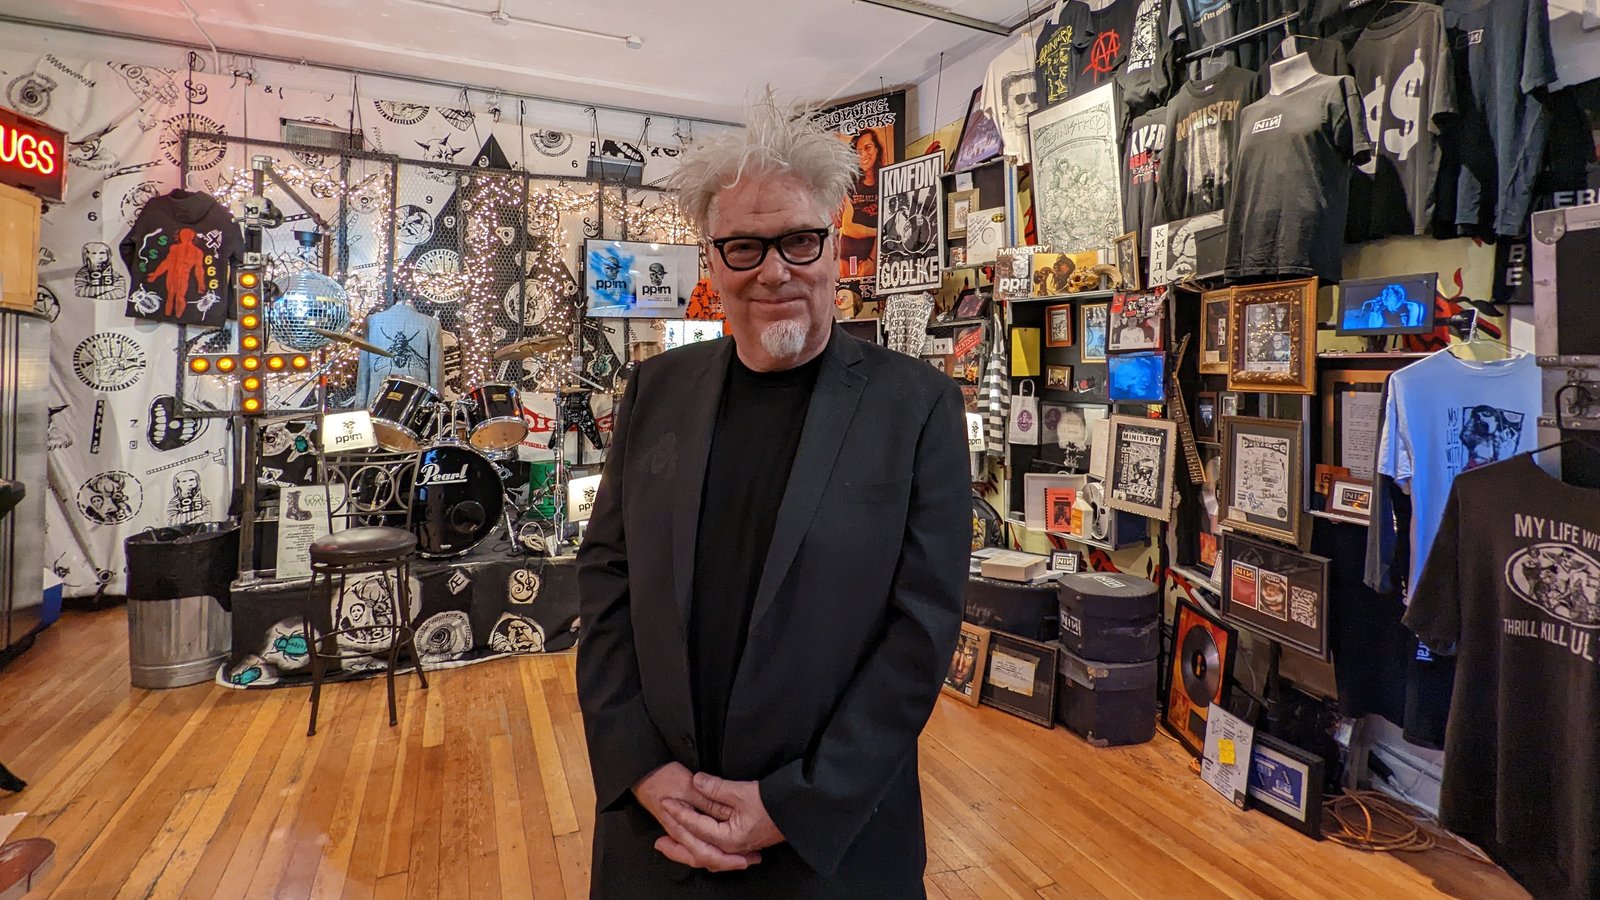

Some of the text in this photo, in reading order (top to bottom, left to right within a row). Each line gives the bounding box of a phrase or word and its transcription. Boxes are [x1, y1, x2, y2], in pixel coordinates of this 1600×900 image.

[0, 124, 54, 174] UGS
[884, 158, 939, 197] KMFDM
[881, 256, 938, 288] GODLIKE
[1123, 432, 1161, 443] MINISTRY
[415, 463, 468, 485] Pearl
[1515, 513, 1545, 538] MY
[1550, 519, 1579, 544] LIFE
[1503, 619, 1538, 638] THRILL
[1541, 621, 1567, 647] KILL
